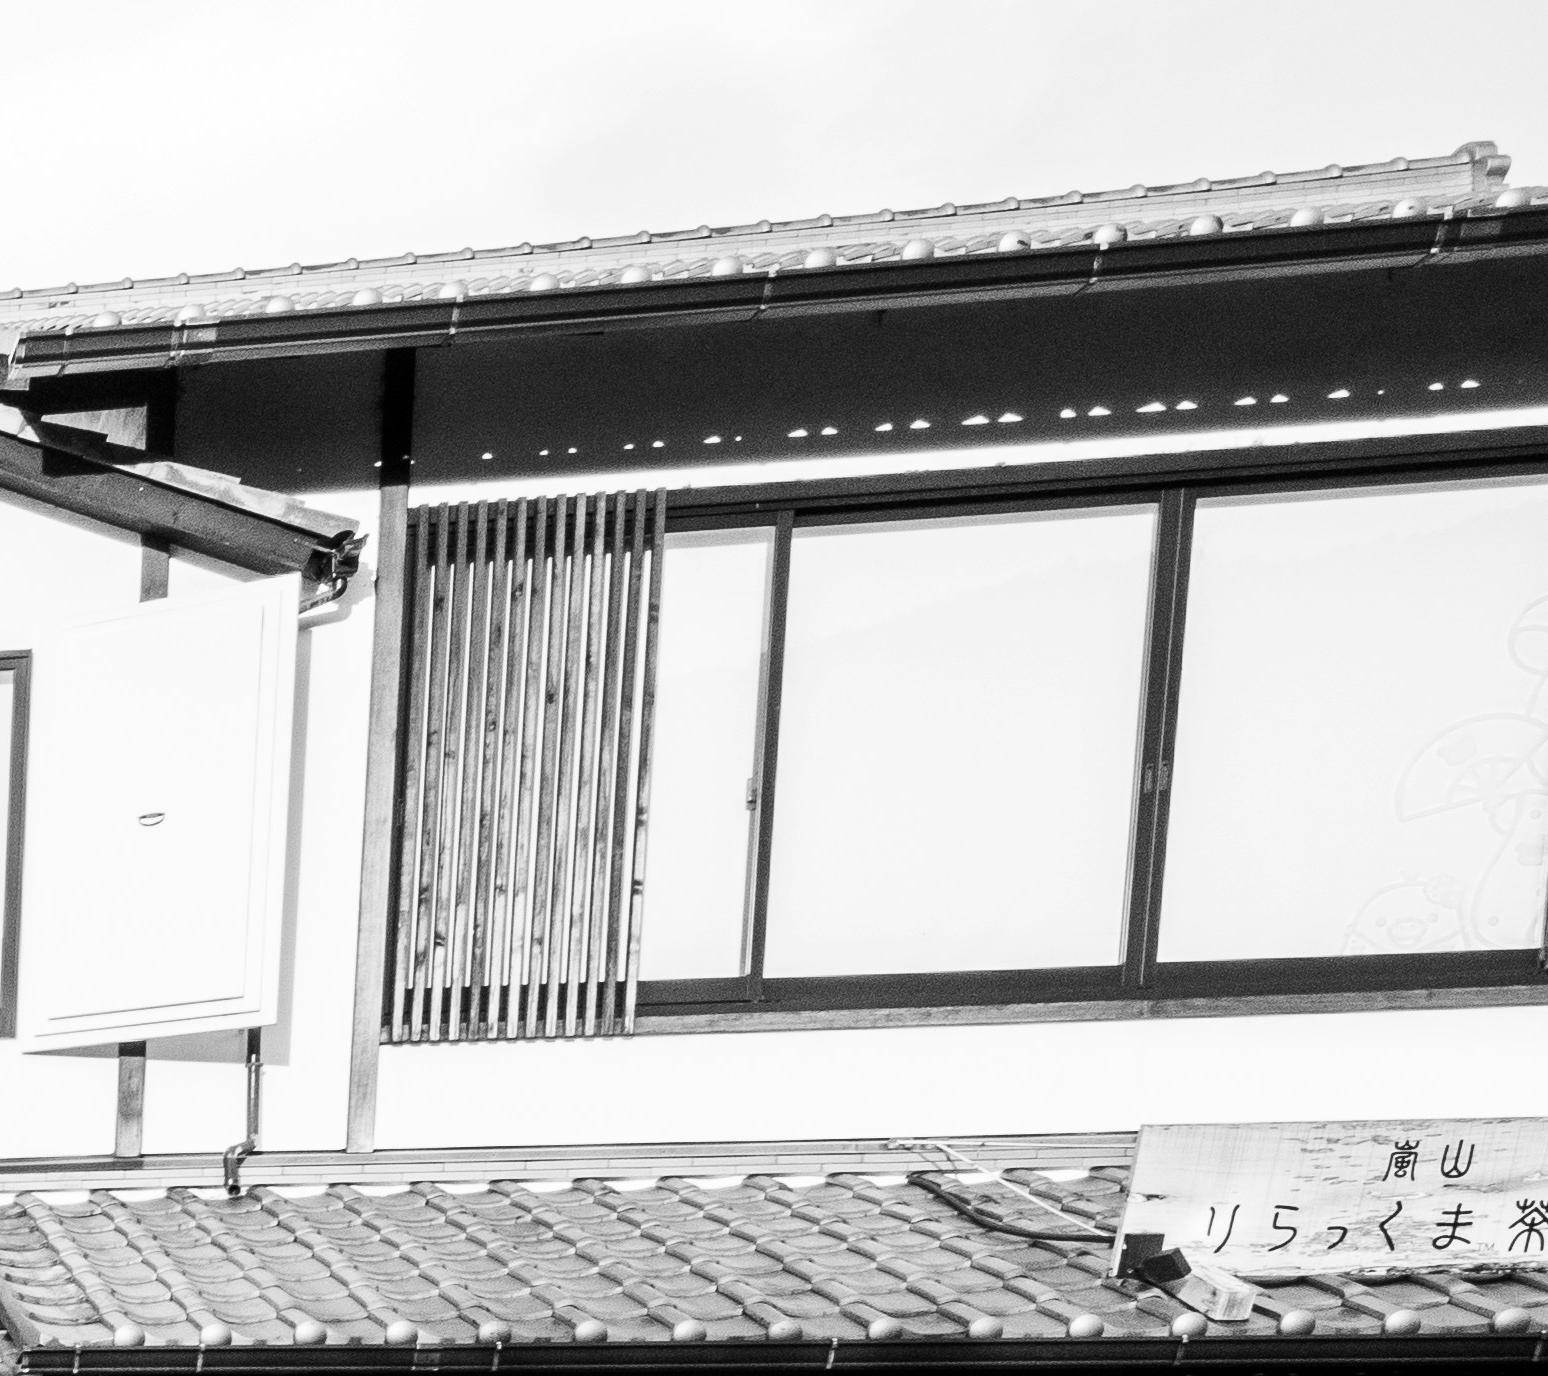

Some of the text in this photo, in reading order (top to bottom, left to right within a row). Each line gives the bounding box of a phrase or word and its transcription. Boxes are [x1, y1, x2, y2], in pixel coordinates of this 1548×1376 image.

[1382, 1140, 1474, 1182] 嵐山
[1208, 1199, 1548, 1253] りらっくま茶
